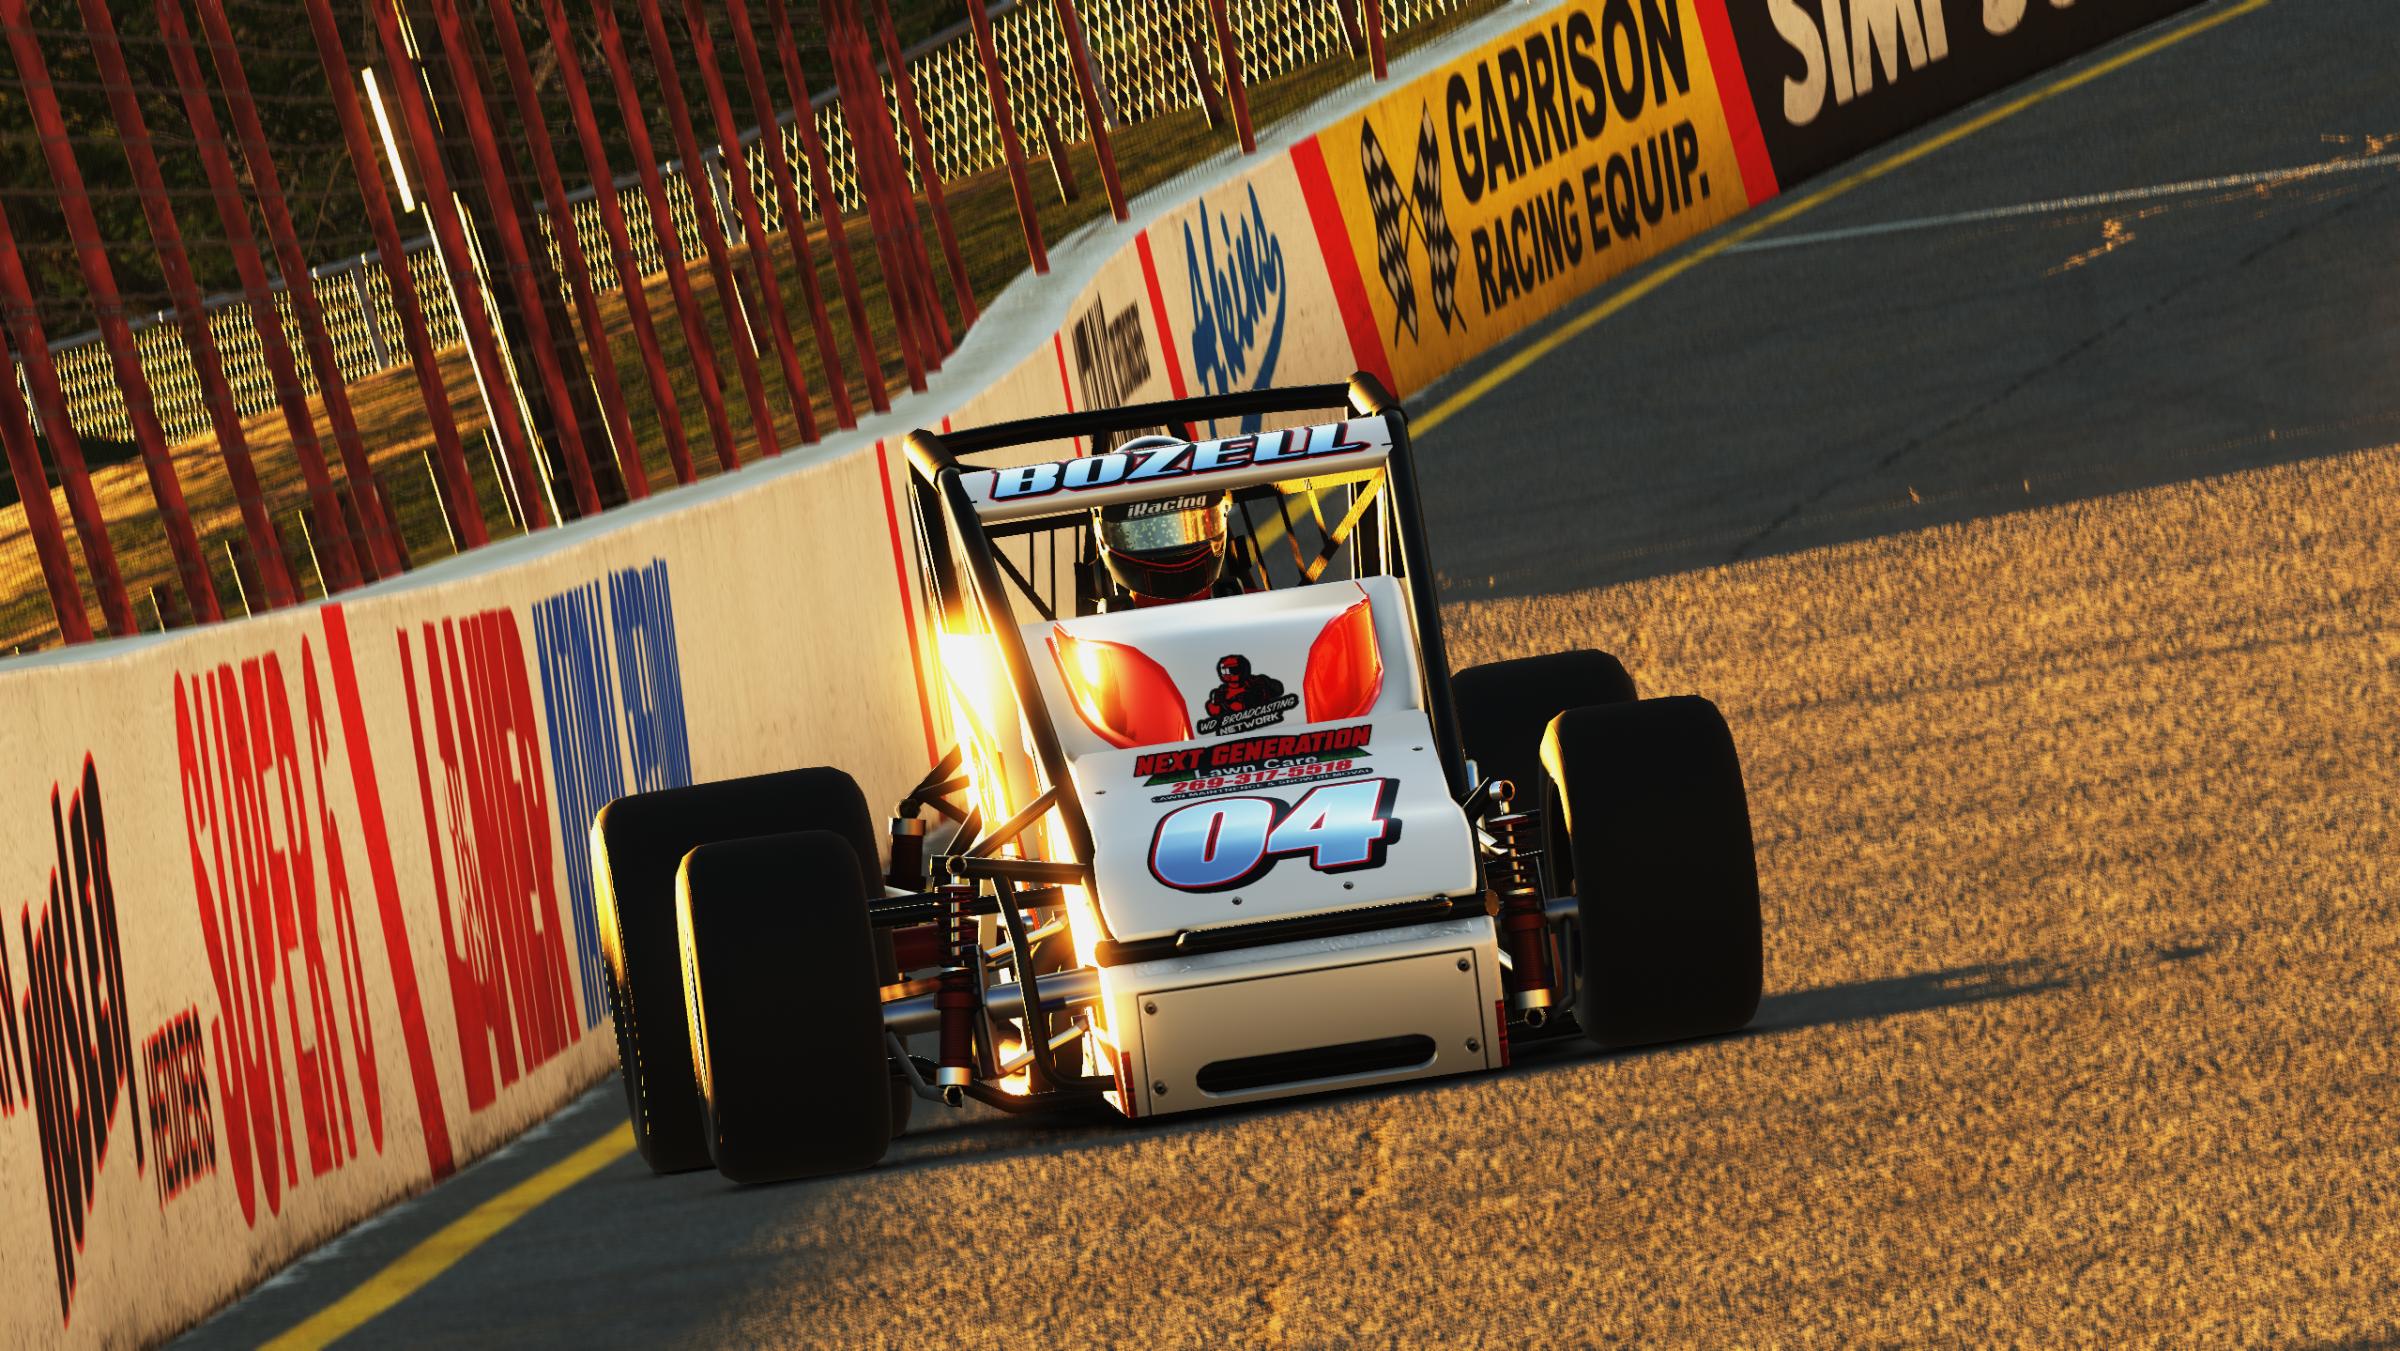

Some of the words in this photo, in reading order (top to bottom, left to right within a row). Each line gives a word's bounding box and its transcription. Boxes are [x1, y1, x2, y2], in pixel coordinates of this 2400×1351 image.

[1446, 0, 1690, 205] GARRISON
[1471, 178, 1583, 316] RACING
[1582, 118, 1711, 254] EQUIP.
[990, 422, 1370, 502] BOZELL
[1127, 495, 1207, 518] iRacing
[1133, 747, 1206, 778] NEXT
[1210, 724, 1373, 767] GENERATION
[1199, 718, 1218, 732] WD
[1221, 696, 1296, 726] BROADCASTING
[1219, 711, 1281, 736] NETWORK
[1170, 758, 1353, 794] 269-317-5518
[1193, 763, 1256, 780] Lawn
[1263, 755, 1318, 770] Care
[396, 606, 582, 1114] LANIER
[1149, 778, 1396, 890] 04
[174, 650, 358, 1231] SUPER
[301, 632, 384, 1158] 6
[142, 1003, 217, 1212] HEDDERS
